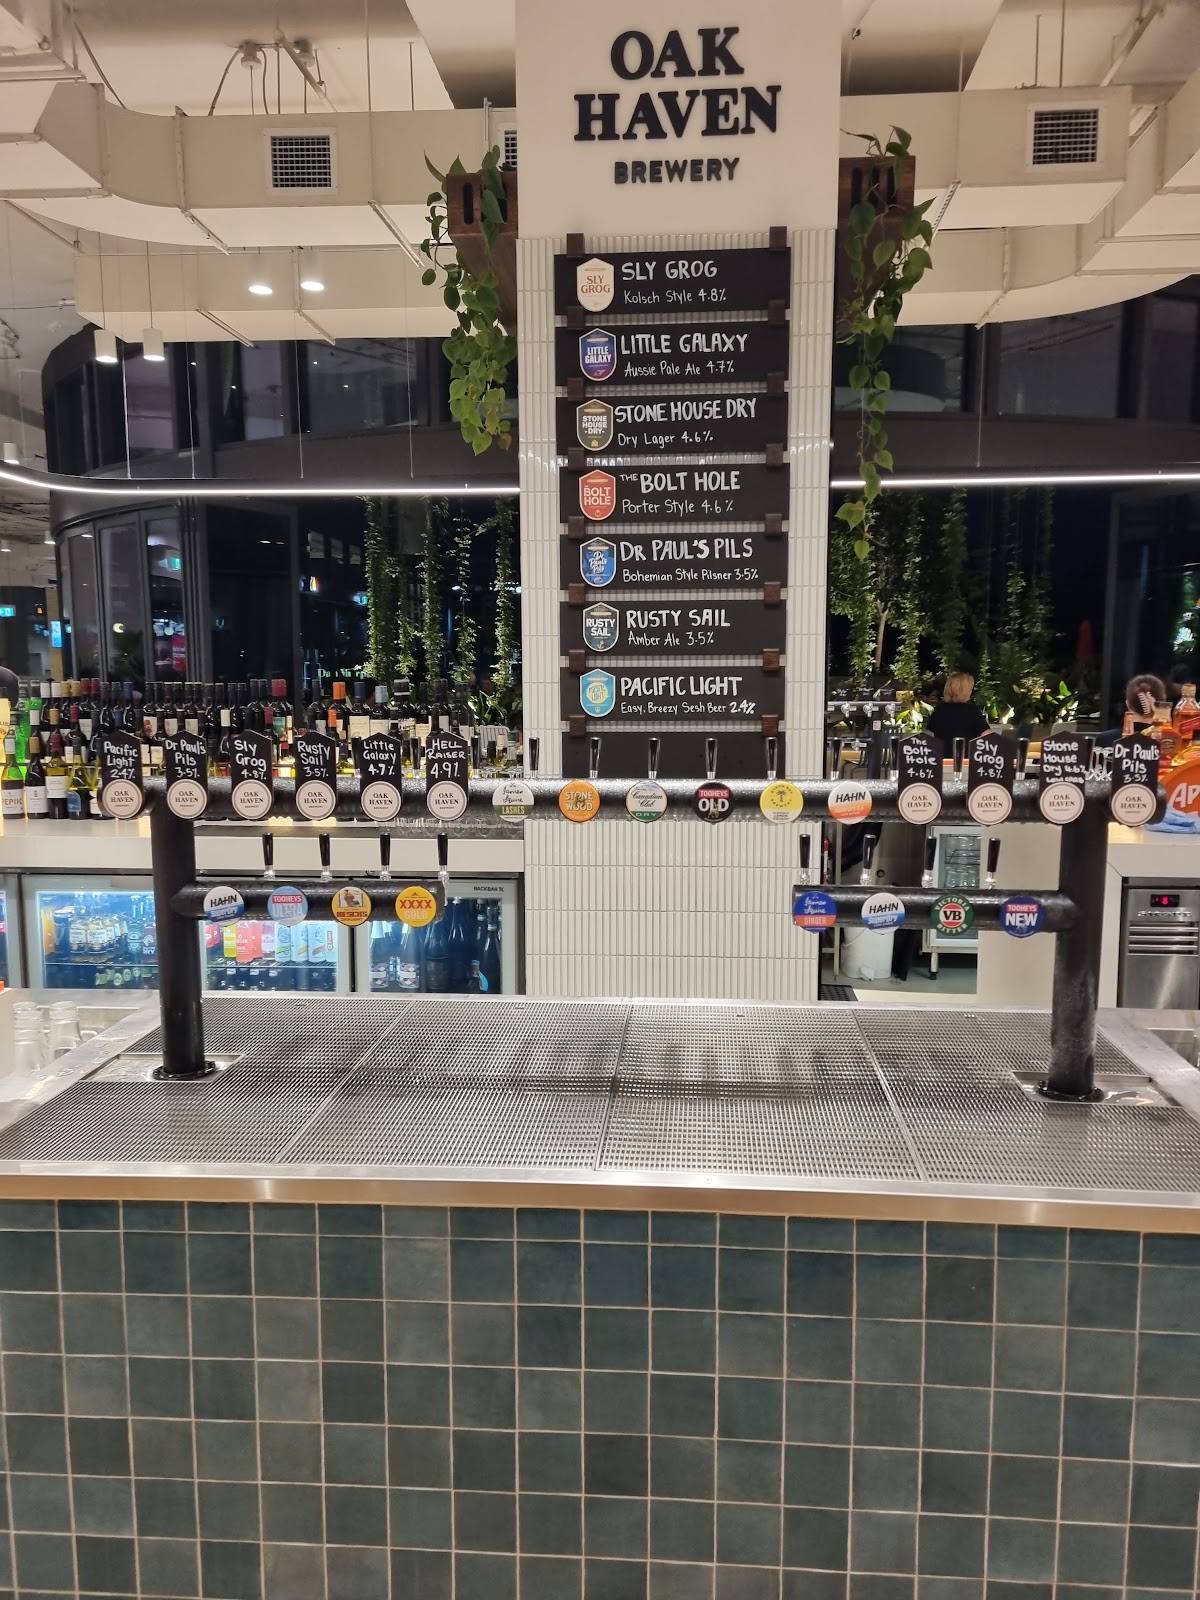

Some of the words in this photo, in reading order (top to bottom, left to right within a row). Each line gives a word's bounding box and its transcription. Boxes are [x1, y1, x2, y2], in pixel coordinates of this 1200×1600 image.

[610, 27, 744, 80] OAK
[574, 85, 782, 141] HAVEN
[614, 157, 740, 184] BREWERY
[621, 261, 657, 281] SLY
[665, 259, 718, 280] GROG
[587, 275, 605, 284] SLY
[580, 284, 611, 294] GROG
[624, 289, 660, 304] Kolsch
[666, 290, 692, 307] Style
[698, 288, 727, 302] 4.8%
[587, 346, 609, 355] LITTLE
[621, 333, 672, 355] LITTLE
[679, 333, 748, 353] GALAXY
[585, 354, 611, 364] GALAXY
[624, 362, 656, 377] Aussie
[659, 360, 680, 375] Pale
[685, 363, 701, 376] Ale
[706, 360, 735, 374] 4.7%
[614, 403, 668, 424] STONE
[670, 400, 722, 422] HOUSE
[726, 398, 757, 418] DRY
[582, 421, 607, 429] HOUSE
[618, 433, 638, 448] Dry
[644, 433, 675, 448] Lager
[619, 474, 638, 482] THE
[640, 472, 687, 494] BOLT
[694, 470, 741, 491] HOLE
[583, 486, 612, 497] BOLT
[583, 496, 612, 506] HOLE
[622, 499, 660, 514] Porter
[664, 499, 695, 517] Style
[652, 539, 710, 561] PAUL'S
[714, 538, 753, 559] PILS
[623, 568, 673, 583] Bohemian
[675, 567, 699, 581] Style
[701, 569, 732, 581] Pilsner
[734, 568, 759, 580] 3.5%
[586, 619, 616, 628] RUSTY
[626, 609, 680, 628] RUSTY
[689, 609, 730, 627] SAIL
[590, 627, 611, 637] SAIL
[628, 632, 660, 646] Amber
[664, 632, 680, 646] Ale
[687, 631, 714, 646] 3.5%
[620, 676, 686, 697] PACIFIC
[690, 676, 742, 696] LIGHT
[648, 702, 678, 715] Breezy
[682, 701, 705, 713] Sesh
[707, 702, 727, 713] Beer
[729, 699, 756, 714] 2.4%
[103, 741, 138, 757] Pacific
[165, 740, 177, 750] Dr
[235, 740, 257, 757] Sly
[363, 740, 394, 750] Little
[432, 738, 462, 749] HELL
[976, 739, 998, 756] Sly
[1043, 741, 1079, 751] Stone
[298, 741, 331, 761] Rusty
[362, 750, 397, 764] Galaxy
[903, 746, 932, 755] Bolt
[1115, 744, 1130, 758] Dr
[106, 754, 136, 768] Light
[175, 753, 197, 767] Pils
[235, 754, 267, 771] Grog
[301, 752, 323, 766] Sail
[906, 756, 937, 766] Hole
[974, 751, 1004, 769] Grog
[1043, 753, 1077, 763] House
[1043, 764, 1062, 776] Dry
[1122, 760, 1147, 774] Pils
[565, 791, 592, 800] STONE
[835, 791, 866, 803] HAHN
[502, 806, 525, 814] LASHES
[567, 803, 593, 811] WOOD
[698, 799, 729, 812] OLD
[210, 895, 237, 907] HAHN
[400, 900, 432, 909] XXXX
[934, 898, 970, 911] VICTORIA
[869, 903, 898, 914] HAHN
[1008, 904, 1037, 912] TOOHEYS
[943, 910, 962, 921] VB
[1005, 913, 1038, 926] NEW
[936, 923, 968, 934] BITTER
